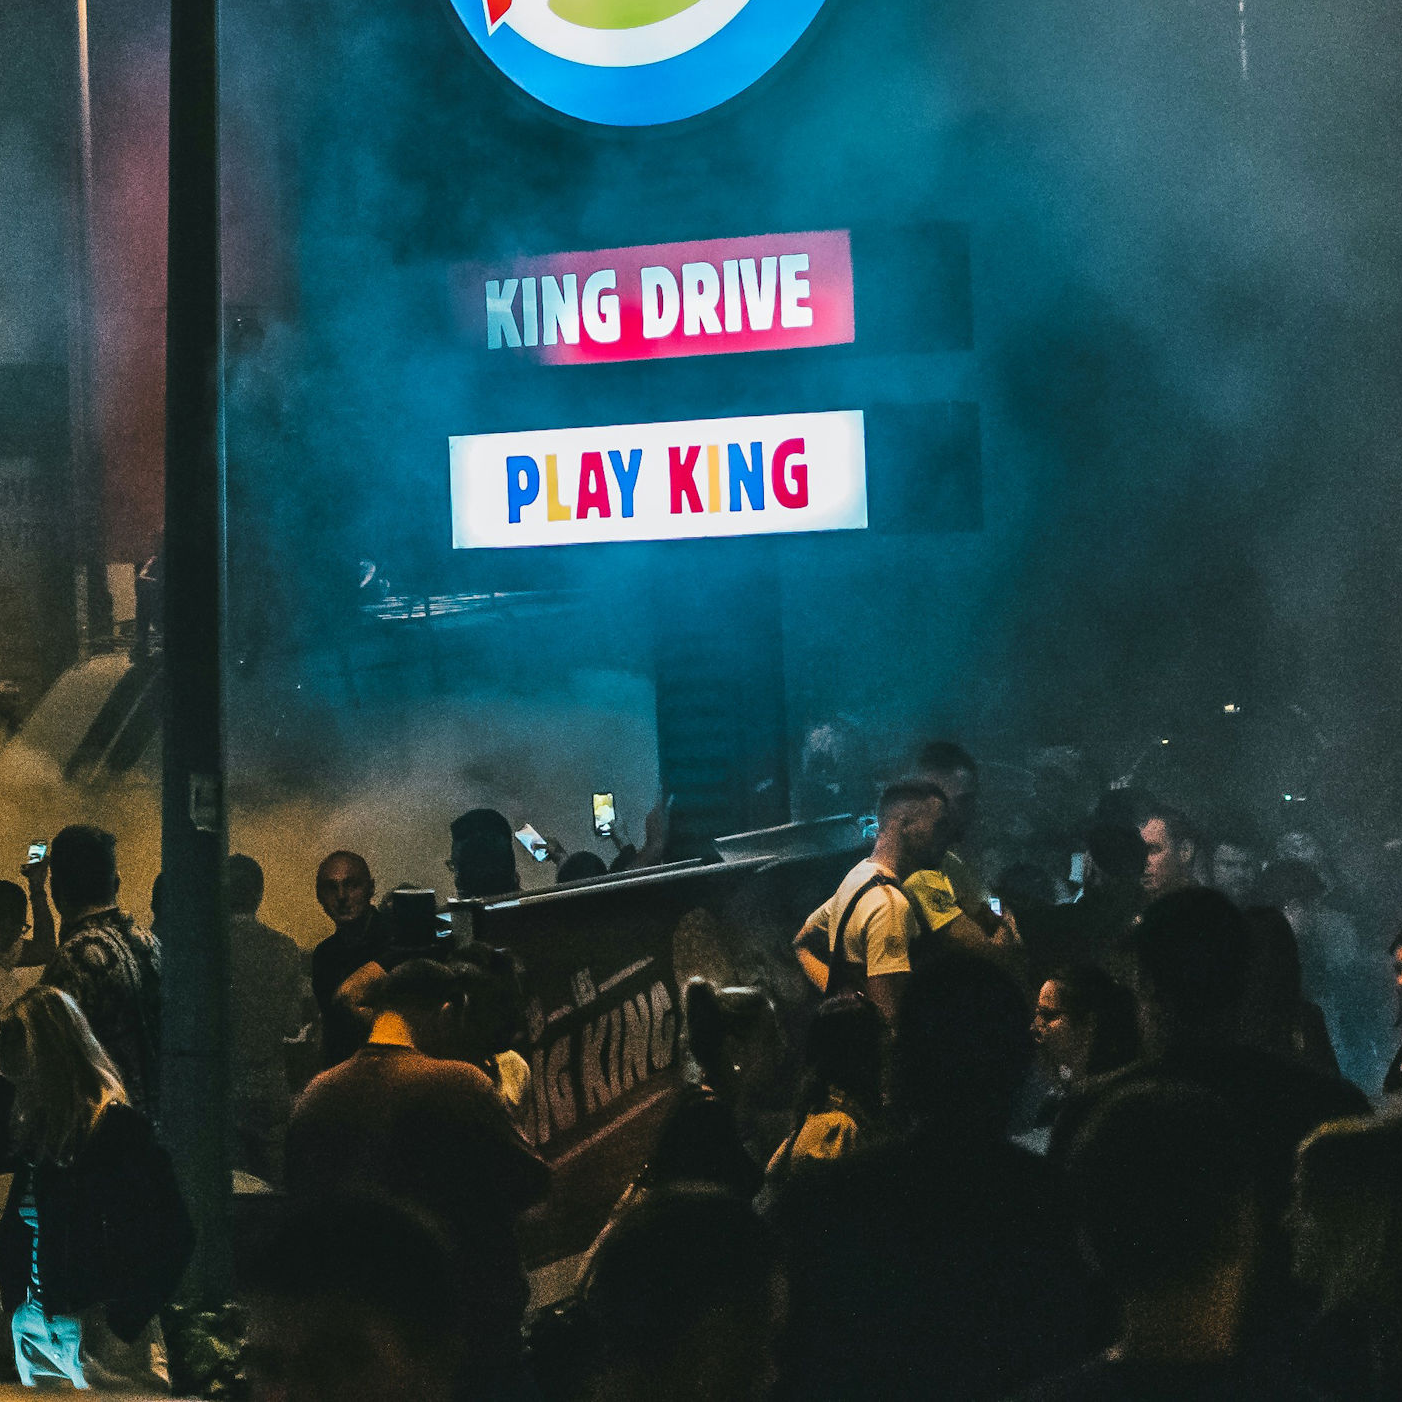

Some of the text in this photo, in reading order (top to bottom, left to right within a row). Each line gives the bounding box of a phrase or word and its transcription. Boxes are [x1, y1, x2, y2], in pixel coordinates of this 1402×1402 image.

[485, 253, 813, 350] KING DRIVE
[506, 438, 810, 524] PLAY KING
[581, 979, 676, 1115] KING
